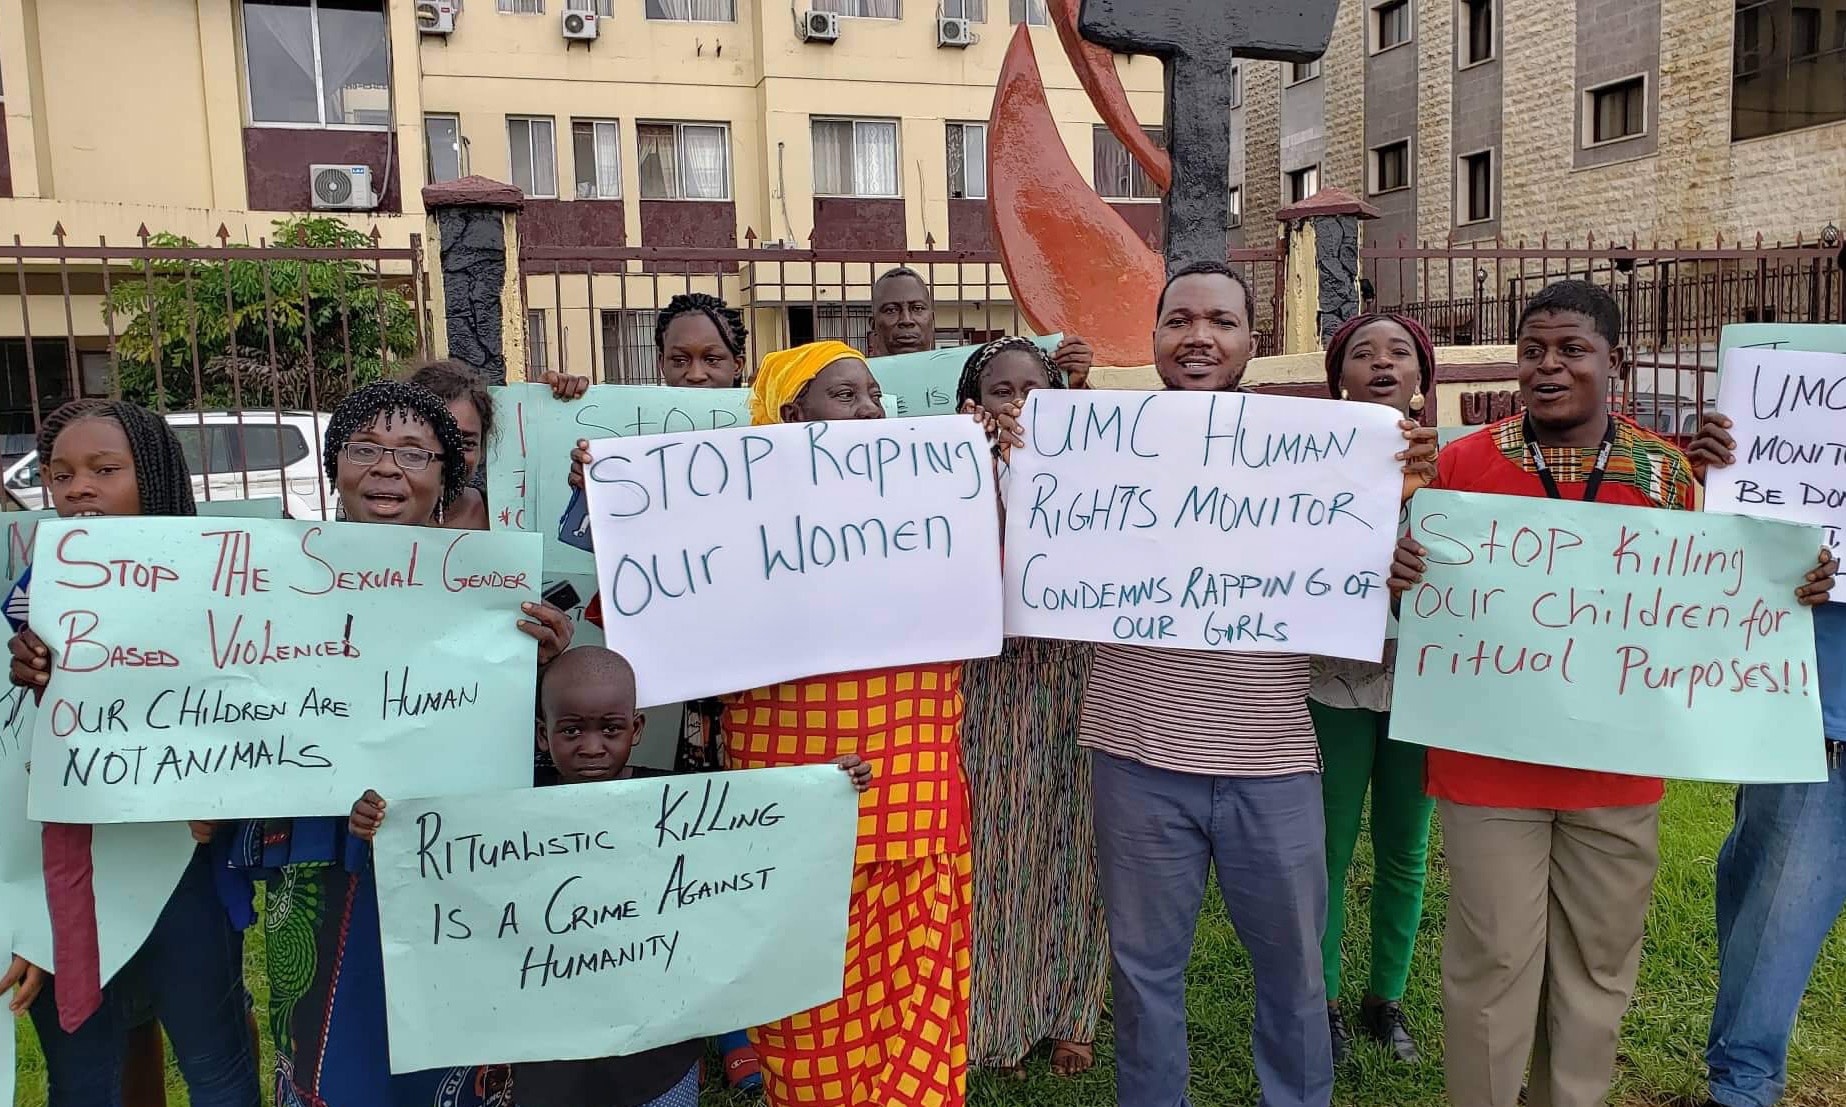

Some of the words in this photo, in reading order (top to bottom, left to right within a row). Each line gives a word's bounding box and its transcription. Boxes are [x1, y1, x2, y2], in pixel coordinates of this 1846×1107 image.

[925, 387, 950, 409] IS
[1753, 364, 1846, 420] UMC
[1032, 393, 1160, 459] UMC
[1203, 394, 1357, 469] HUMAN
[590, 436, 773, 518] STOP
[1029, 473, 1159, 538] RIGHTS
[1175, 485, 1375, 532] MONITOR
[1734, 480, 1785, 506] BE
[55, 528, 180, 593] STOP
[201, 530, 269, 597] THE
[289, 526, 423, 595] SEXUAL
[443, 532, 532, 593] GENDER
[1022, 553, 1173, 611] CONDEMNS
[1344, 570, 1382, 600] OF
[1612, 525, 1745, 596] Killing
[56, 610, 180, 673] BASED
[1112, 614, 1178, 641] OUR
[1203, 612, 1290, 647] GIRLS
[1740, 597, 1792, 651] for
[1418, 633, 1576, 684] ritual
[51, 698, 129, 738] OUR
[146, 686, 288, 732] CHILDREN
[299, 687, 351, 721] ARE
[383, 665, 479, 723] HUMAN
[416, 811, 616, 881] RITUALISTIC
[655, 778, 786, 848] KILLING
[434, 903, 472, 945] IS
[497, 902, 520, 940] A
[545, 875, 641, 935] CRIME
[657, 854, 777, 914] AGAINST
[520, 930, 680, 990] HUMANITY
